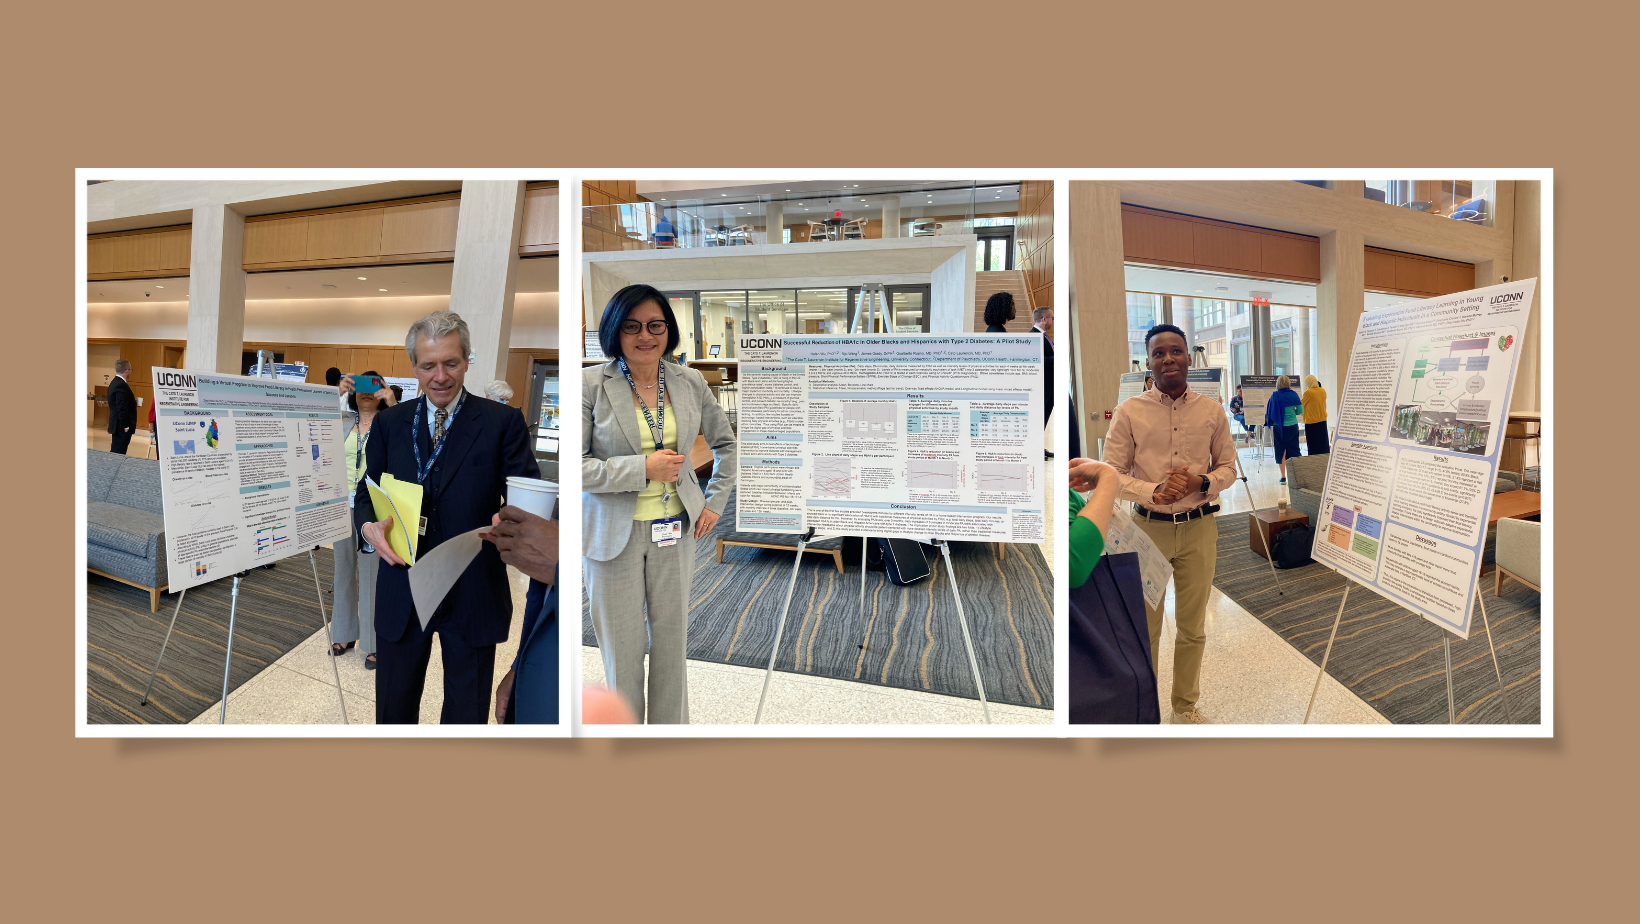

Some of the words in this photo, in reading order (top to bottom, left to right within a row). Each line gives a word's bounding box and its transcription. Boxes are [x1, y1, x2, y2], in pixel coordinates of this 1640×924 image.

[1490, 292, 1523, 304] UCONN
[1436, 300, 1458, 308] Learning
[1431, 308, 1459, 317] Community
[741, 339, 782, 348] UCONN
[157, 372, 196, 388] UCONN
